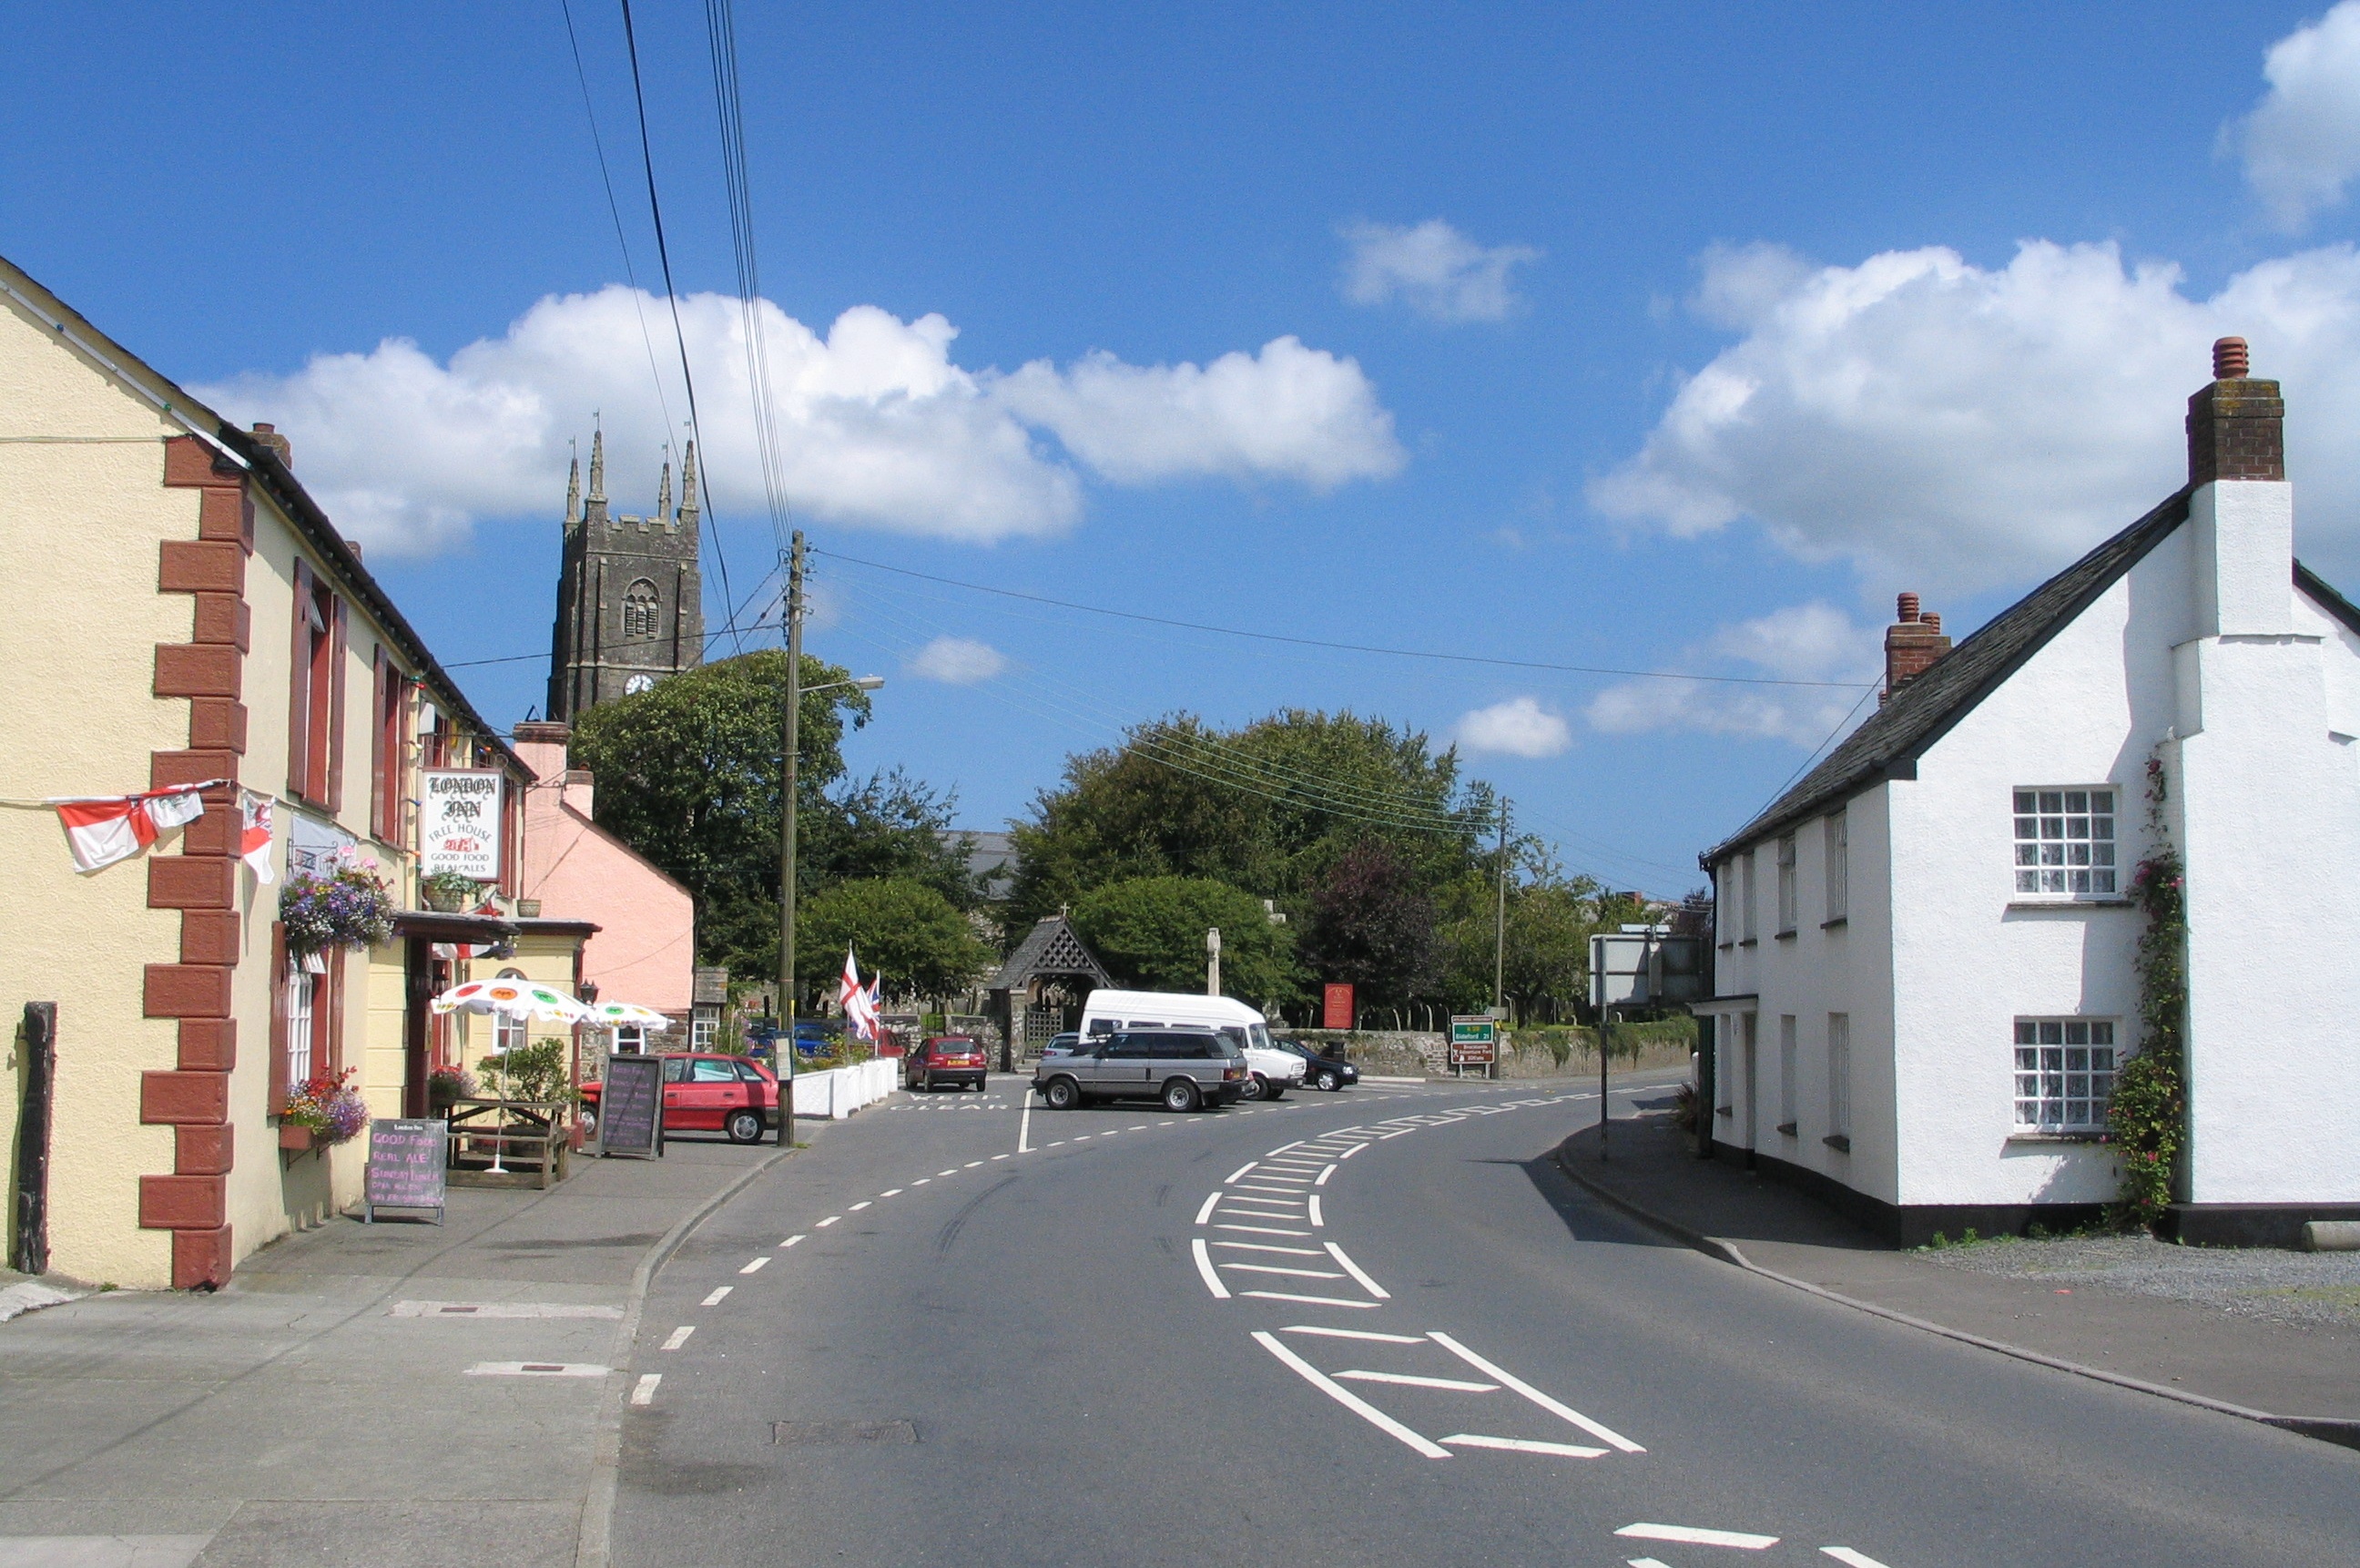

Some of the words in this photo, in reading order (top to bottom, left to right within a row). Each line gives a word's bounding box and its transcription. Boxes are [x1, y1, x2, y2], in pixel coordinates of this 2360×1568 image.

[428, 777, 496, 799] LONDON
[441, 800, 482, 823] INN
[429, 824, 453, 842] FREE
[458, 823, 492, 843] HOUSE
[431, 853, 460, 861] GOOD
[463, 853, 490, 861] FOOD
[372, 1132, 406, 1145] GOOD
[372, 1151, 401, 1162] REAL
[405, 1154, 427, 1164] ALE
